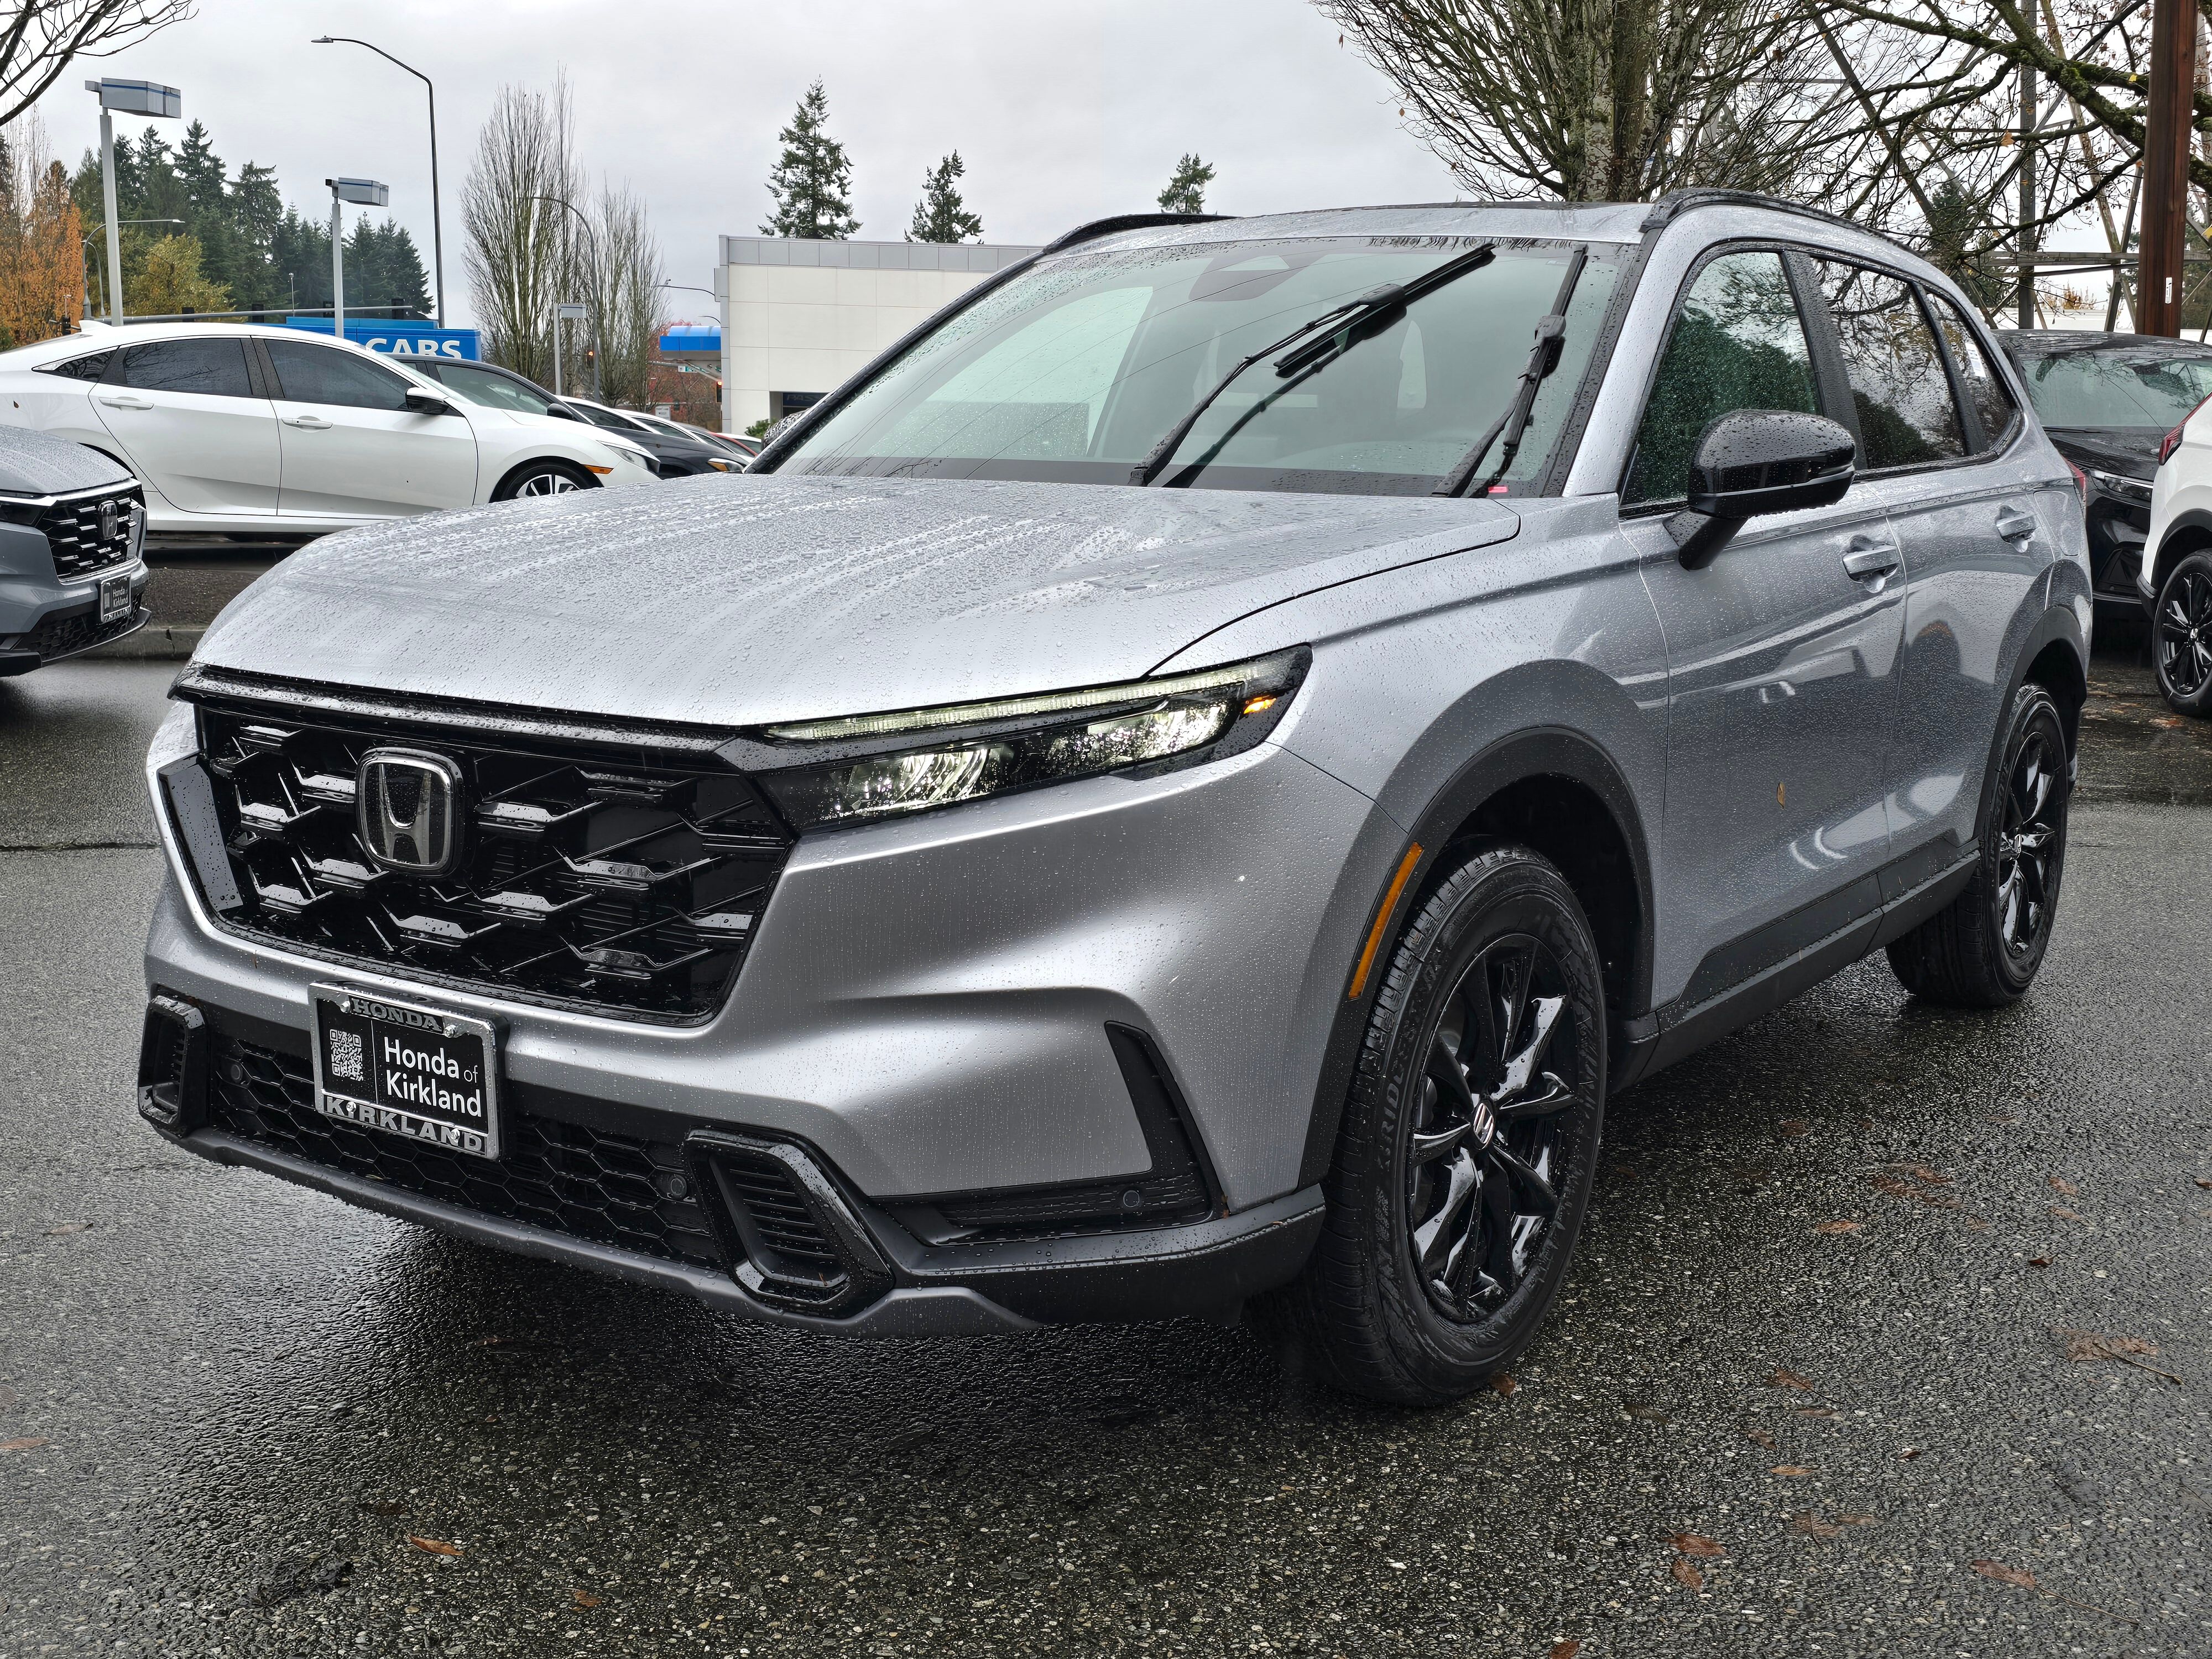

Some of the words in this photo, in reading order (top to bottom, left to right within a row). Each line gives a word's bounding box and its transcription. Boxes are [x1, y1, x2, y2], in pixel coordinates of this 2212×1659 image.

[366, 338, 462, 359] CARS
[352, 998, 442, 1032] HONDA
[384, 1036, 459, 1078] Honda
[463, 1065, 478, 1083] of
[386, 1070, 481, 1117] Kirkland
